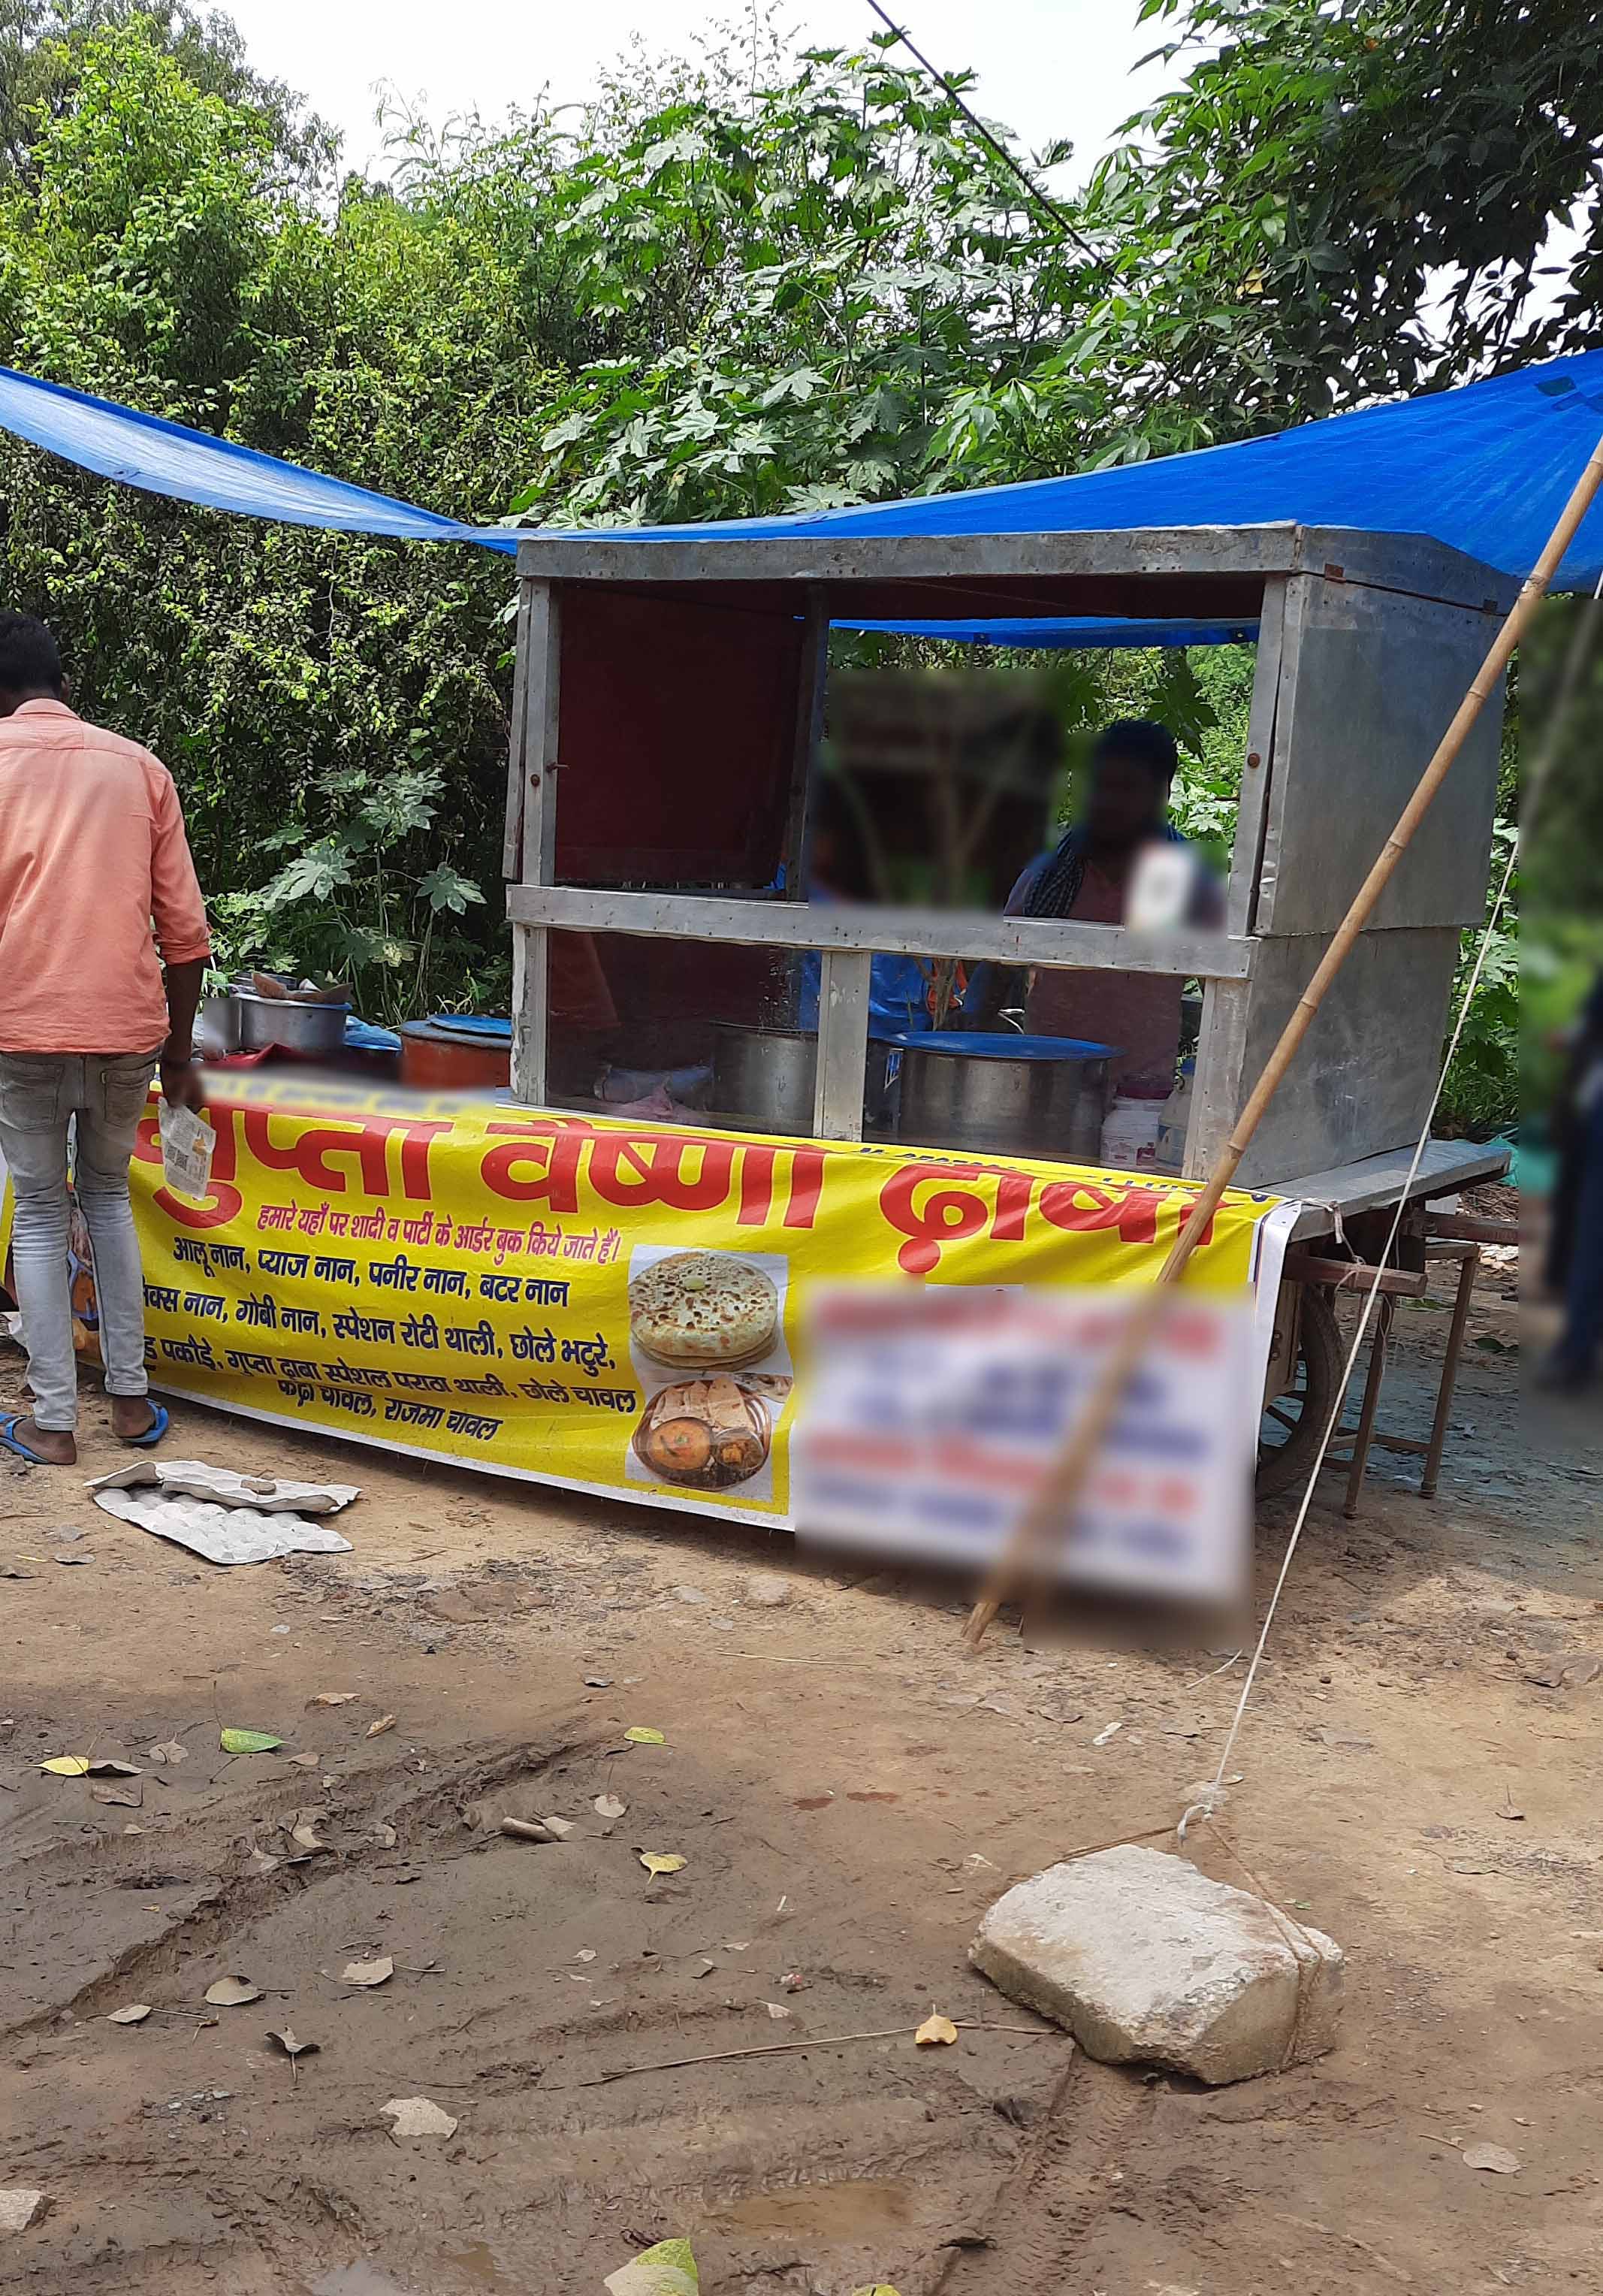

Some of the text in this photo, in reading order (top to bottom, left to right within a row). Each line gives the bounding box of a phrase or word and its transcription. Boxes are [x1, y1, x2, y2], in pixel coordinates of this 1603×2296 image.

[258, 1199, 296, 1231] हमारे
[298, 1202, 328, 1234] यहाँ
[330, 1212, 349, 1237] पर
[352, 1206, 386, 1240] शादी
[386, 1218, 400, 1240] व
[403, 1210, 433, 1244] पार्टी
[436, 1213, 453, 1246] के
[494, 1228, 526, 1265] बुक
[527, 1221, 563, 1256] किये
[564, 1227, 598, 1260] जाते
[174, 1237, 570, 1307] आलू नान, प्याज नान, पनीर नान, बटर नान
[184, 1292, 228, 1323] नान,
[236, 1292, 277, 1329] गोबी
[280, 1307, 326, 1338] नान,
[400, 1314, 439, 1349] रोटी
[445, 1320, 503, 1359] थाली,
[509, 1326, 557, 1363] छोले
[384, 1397, 445, 1429] राजमा
[445, 1410, 503, 1440] चावल
[517, 1378, 570, 1403] छोले
[569, 1386, 636, 1413] चावल
